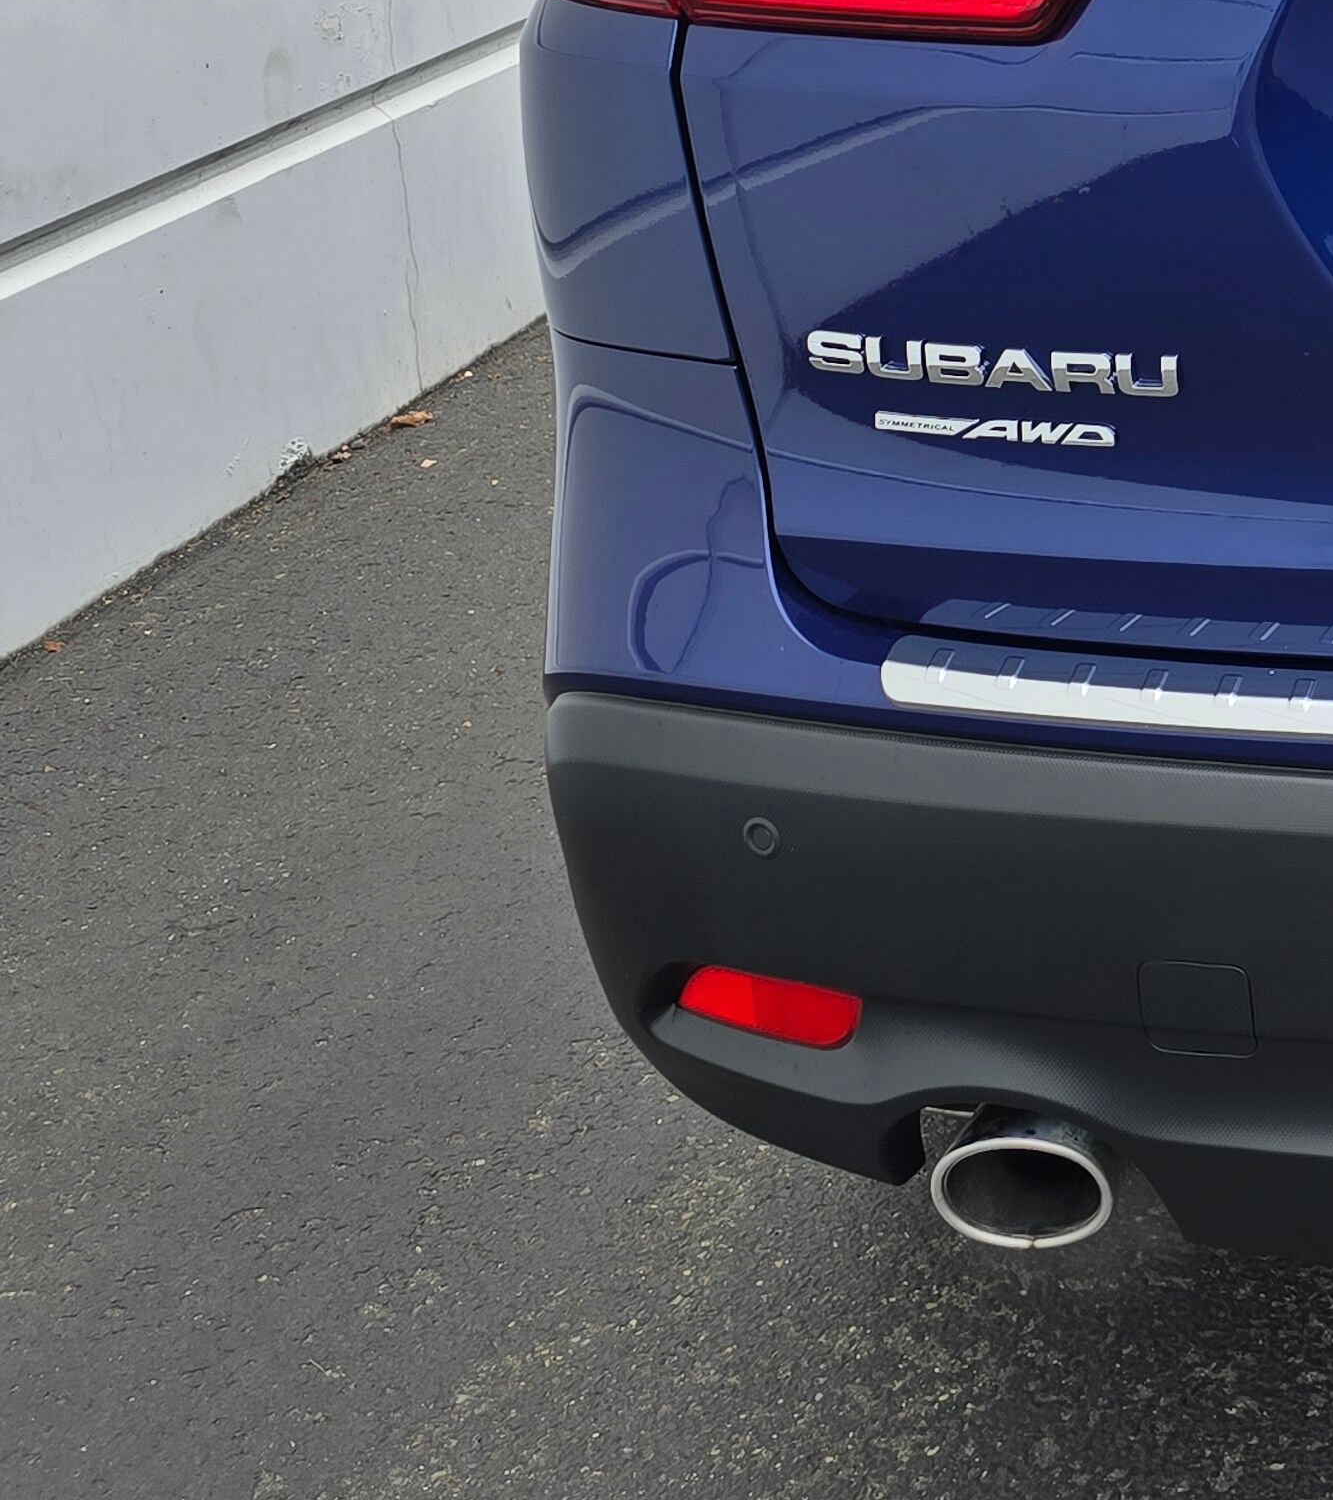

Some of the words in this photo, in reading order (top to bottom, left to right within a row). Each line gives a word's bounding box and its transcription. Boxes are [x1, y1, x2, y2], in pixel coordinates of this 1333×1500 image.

[807, 329, 1179, 398] SUBARU
[878, 418, 956, 433] SYMMETRICAL
[962, 419, 1117, 446] AWD
